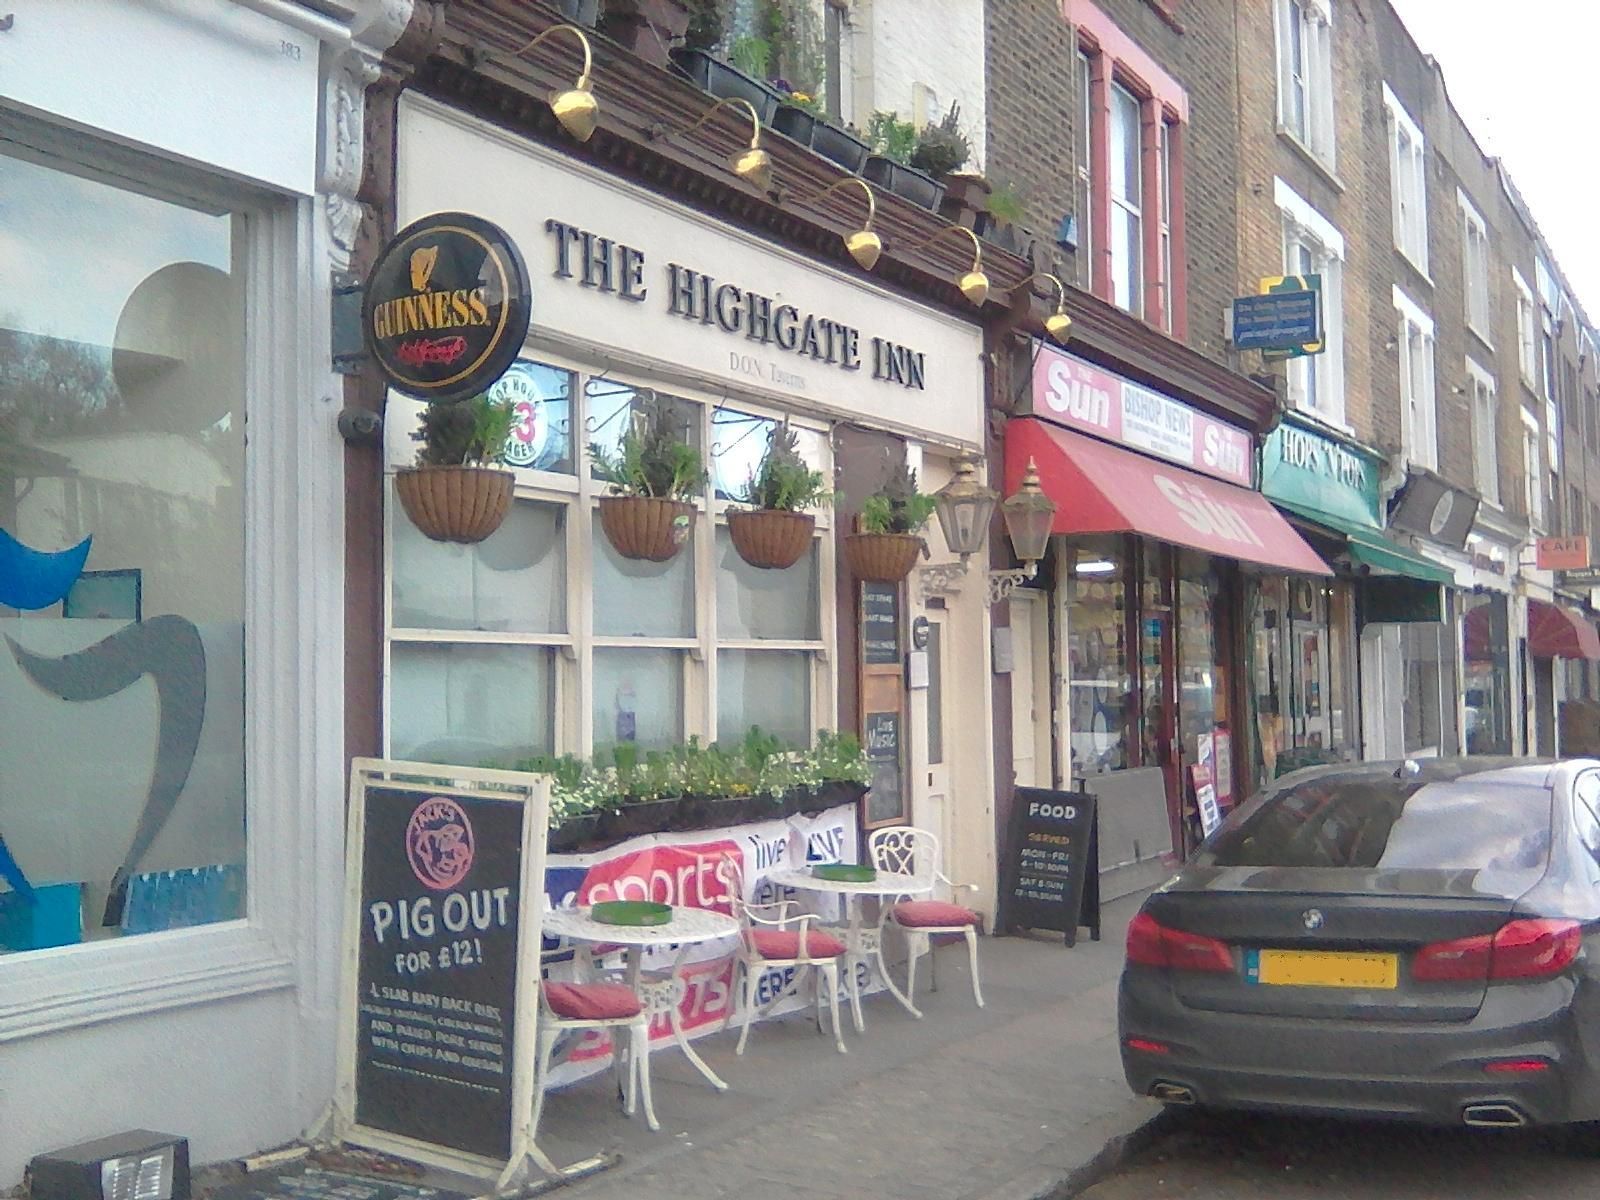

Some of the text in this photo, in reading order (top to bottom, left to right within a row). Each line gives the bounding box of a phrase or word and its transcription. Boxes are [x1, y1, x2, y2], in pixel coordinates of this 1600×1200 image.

[373, 287, 489, 340] GUINNESS
[545, 218, 927, 391] THE HIGHGATE INN
[1045, 359, 1111, 429] Sun
[1202, 424, 1246, 475] Sun
[1029, 802, 1076, 820] FOOD
[1028, 832, 1070, 845] SERVED
[370, 896, 436, 944] PIG
[443, 887, 510, 932] OUT
[394, 938, 484, 974] FOR £12!
[382, 986, 410, 1002] SLAB
[441, 996, 473, 1014] BACK
[371, 1019, 393, 1033] AND
